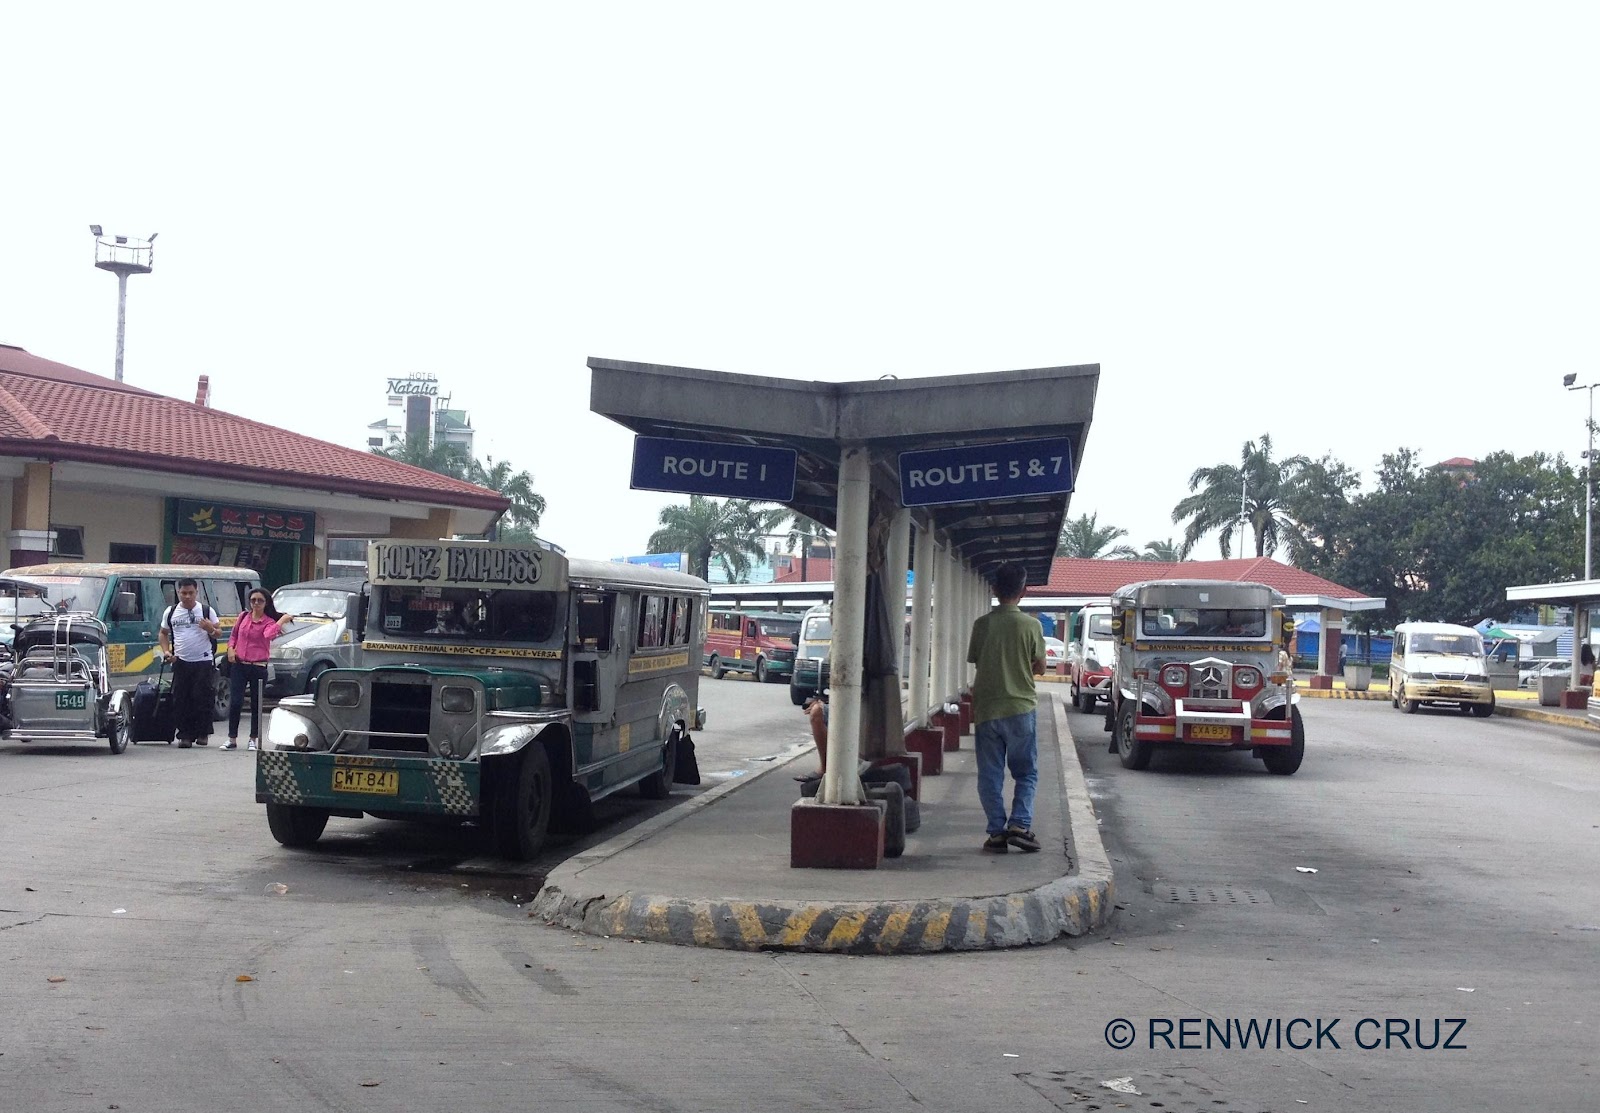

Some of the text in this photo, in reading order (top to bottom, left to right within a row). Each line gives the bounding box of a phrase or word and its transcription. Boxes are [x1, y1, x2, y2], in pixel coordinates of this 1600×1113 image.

[409, 371, 438, 381] HOTEL
[385, 380, 438, 395] Natalia
[663, 455, 749, 480] ROUTE
[909, 456, 1063, 488] ROUTE 5 & 7
[375, 544, 543, 586] LOPEZ EXPRESS
[366, 642, 408, 651] BAYANIHAN
[409, 644, 448, 653] TERMINAL
[453, 646, 475, 654] MPC
[56, 694, 85, 708] 1549
